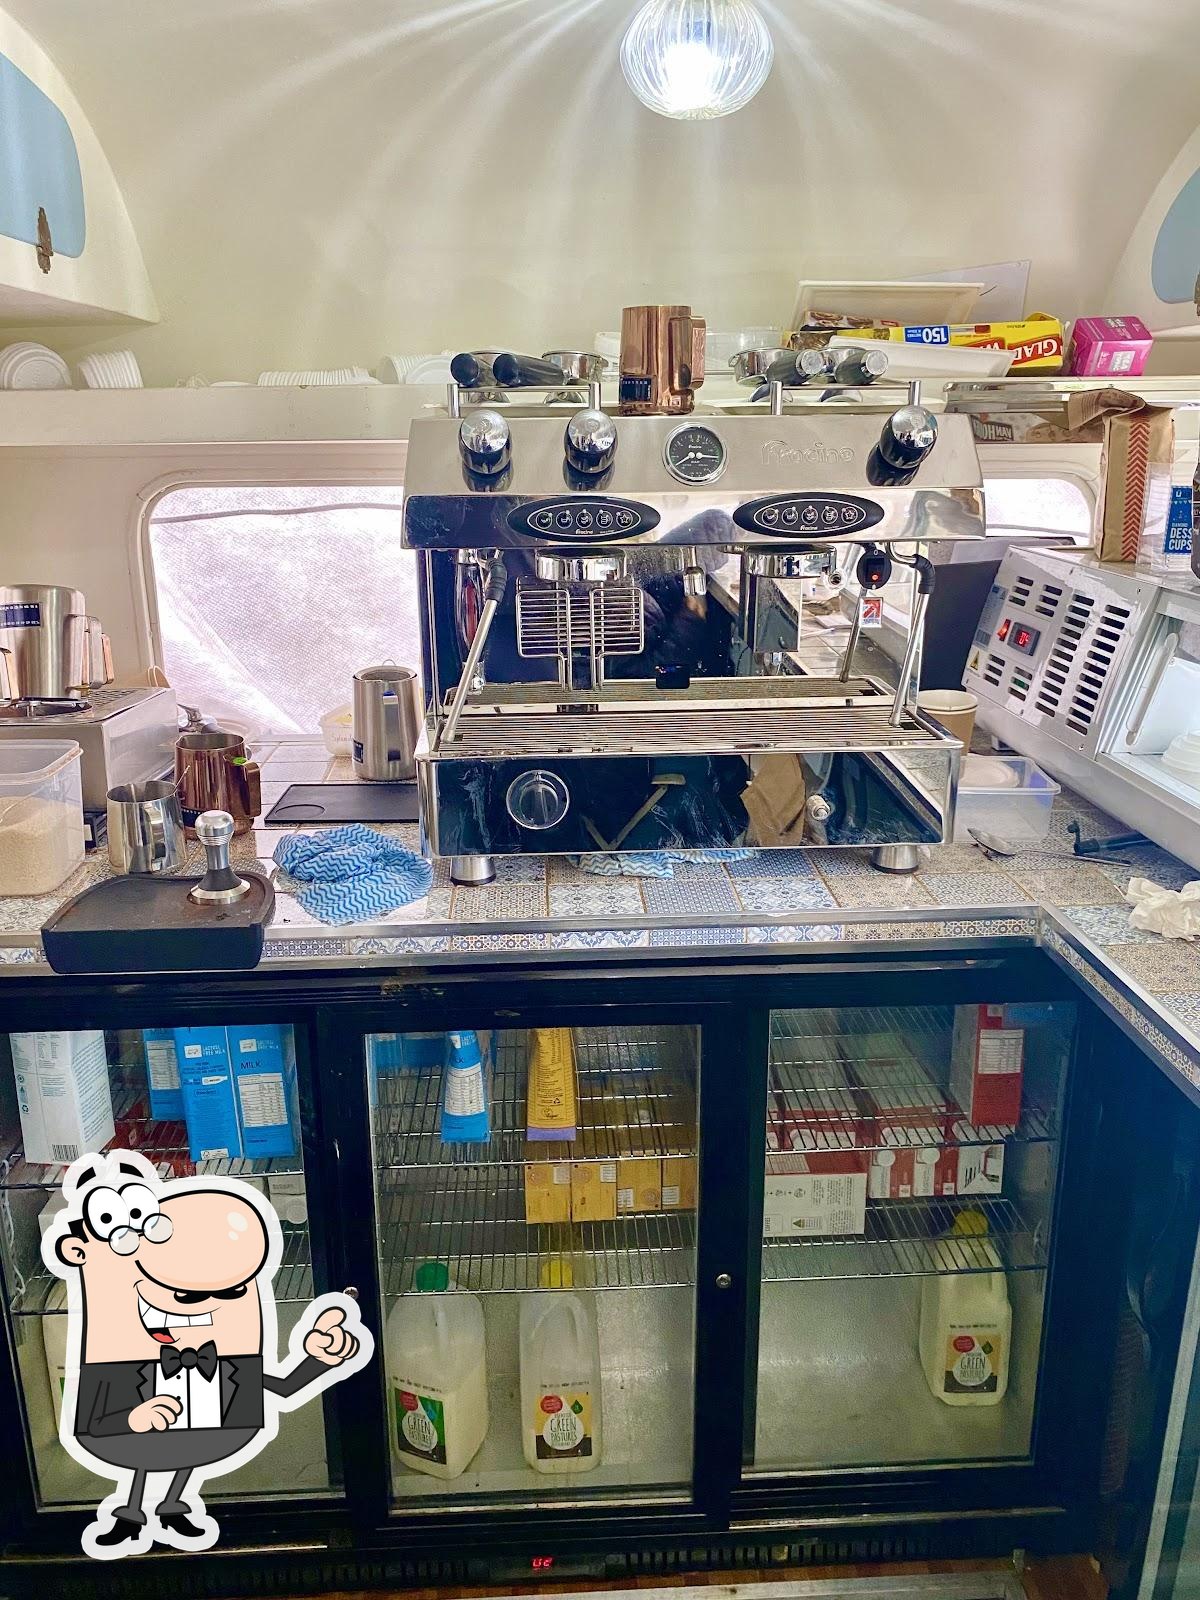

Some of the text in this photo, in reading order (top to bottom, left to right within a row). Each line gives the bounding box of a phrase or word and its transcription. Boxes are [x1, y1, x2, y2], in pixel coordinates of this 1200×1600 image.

[922, 327, 947, 343] 150
[1012, 338, 1059, 361] GLAD
[1168, 539, 1192, 551] CUPS
[241, 1060, 262, 1070] MILK
[961, 1356, 986, 1370] GREEN
[407, 1415, 432, 1435] GREEN
[550, 1417, 577, 1432] GREEN
[550, 1432, 578, 1441] PASTURES
